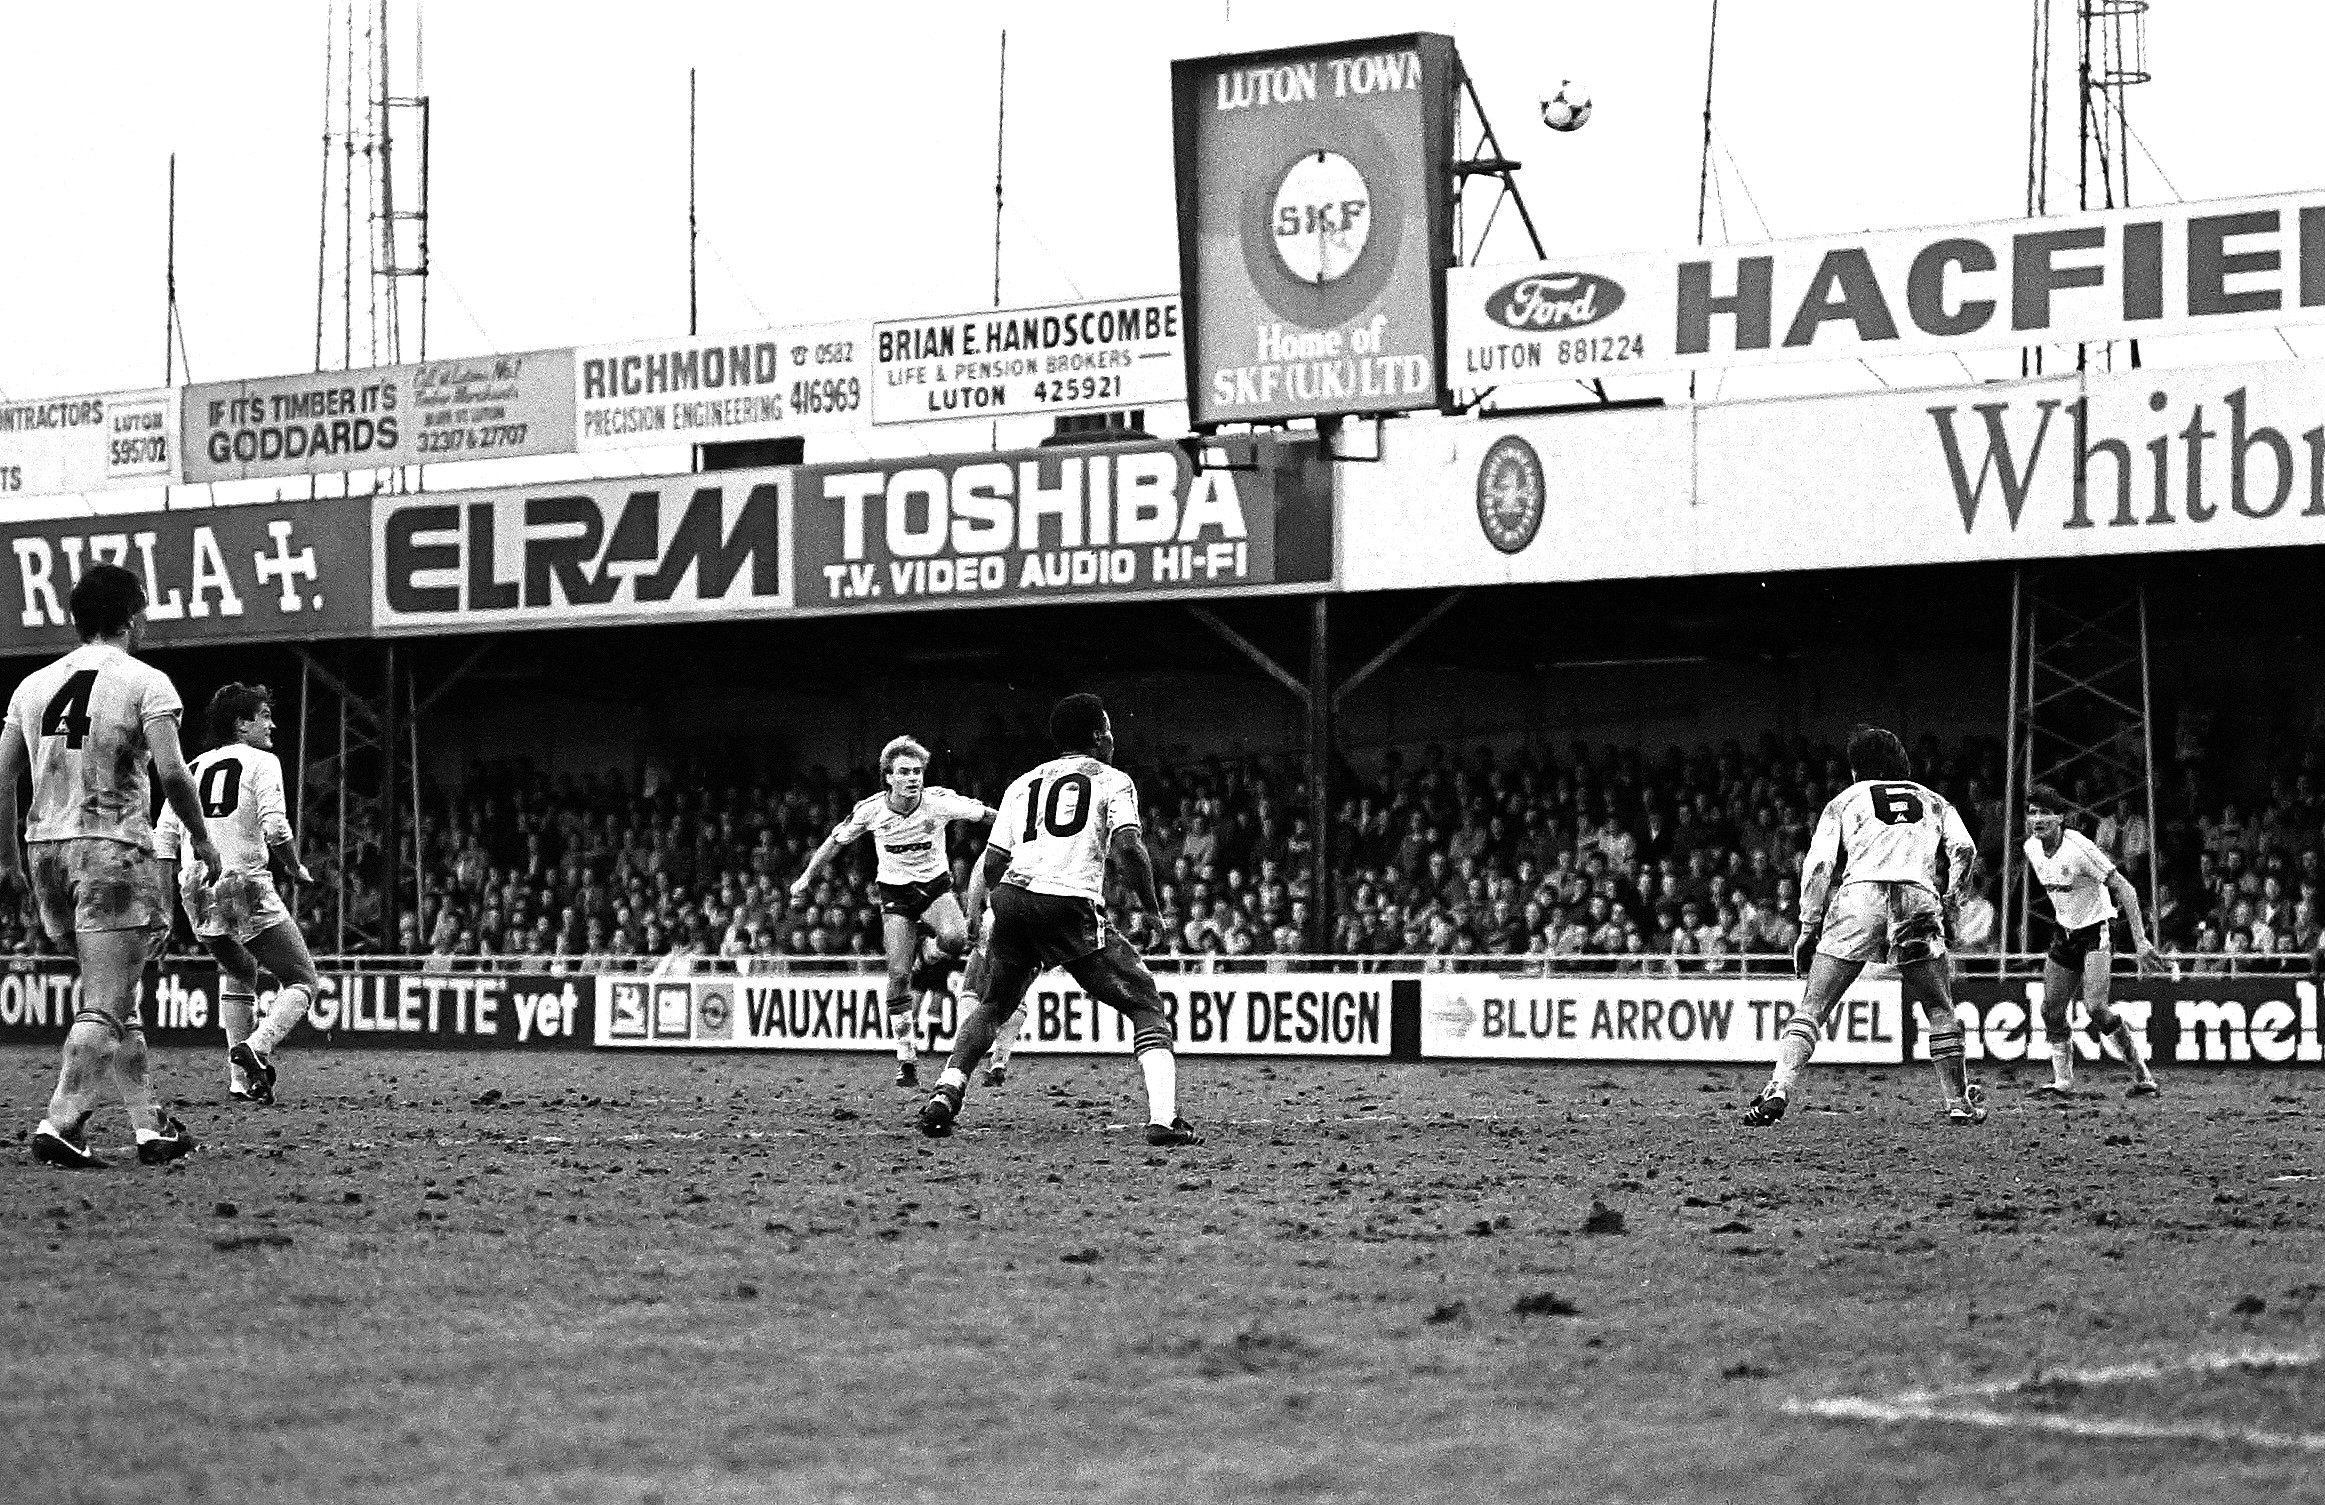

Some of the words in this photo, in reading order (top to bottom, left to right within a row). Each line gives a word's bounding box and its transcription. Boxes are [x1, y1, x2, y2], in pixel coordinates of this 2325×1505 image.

[1217, 62, 1317, 110] LUTON
[1328, 52, 1422, 98] TOWN
[1277, 199, 1367, 236] SKF
[1506, 276, 1597, 327] Ford
[879, 325, 955, 363] BRIAN
[986, 304, 1178, 352] HANDSCOMBE
[1257, 322, 1343, 362] Home
[1350, 314, 1388, 354] of
[1467, 342, 1541, 372] LUTON
[1558, 333, 1645, 365] 881224
[583, 341, 777, 399] RICHMOND
[887, 366, 927, 386] LIFE
[936, 363, 947, 382] &
[955, 356, 1038, 381] PENSION
[1045, 348, 1133, 374] BROKERS
[0, 399, 104, 432] NTRACTORS
[271, 387, 355, 422] TIMBER
[584, 405, 667, 437] PRECISION
[672, 393, 784, 430] ENGINEERING
[790, 376, 861, 414] 416969
[928, 384, 1006, 411] LUTON
[1034, 374, 1122, 403] 425921
[113, 411, 163, 433] LUTON
[207, 415, 400, 463] GODDARDS
[823, 448, 1247, 560] TOSHIBA
[823, 562, 882, 599] T.V.
[889, 556, 1005, 595] VIDEO
[1019, 549, 1136, 589] AUDIO
[1151, 541, 1248, 582] HI-FI
[40, 668, 100, 751] 4
[187, 757, 244, 819] 0
[1022, 772, 1092, 844] 10
[1868, 783, 1925, 826] 6
[156, 974, 209, 1028] the
[308, 976, 500, 1033] GILLETTE
[513, 982, 579, 1042] yet
[1190, 991, 1236, 1044] BY
[1248, 991, 1381, 1045] DESIGN
[1482, 997, 1577, 1038] BLUE
[1589, 998, 1734, 1042] ARROW
[1748, 1000, 1893, 1043] TRVEL
[2175, 980, 2325, 1061] mel
